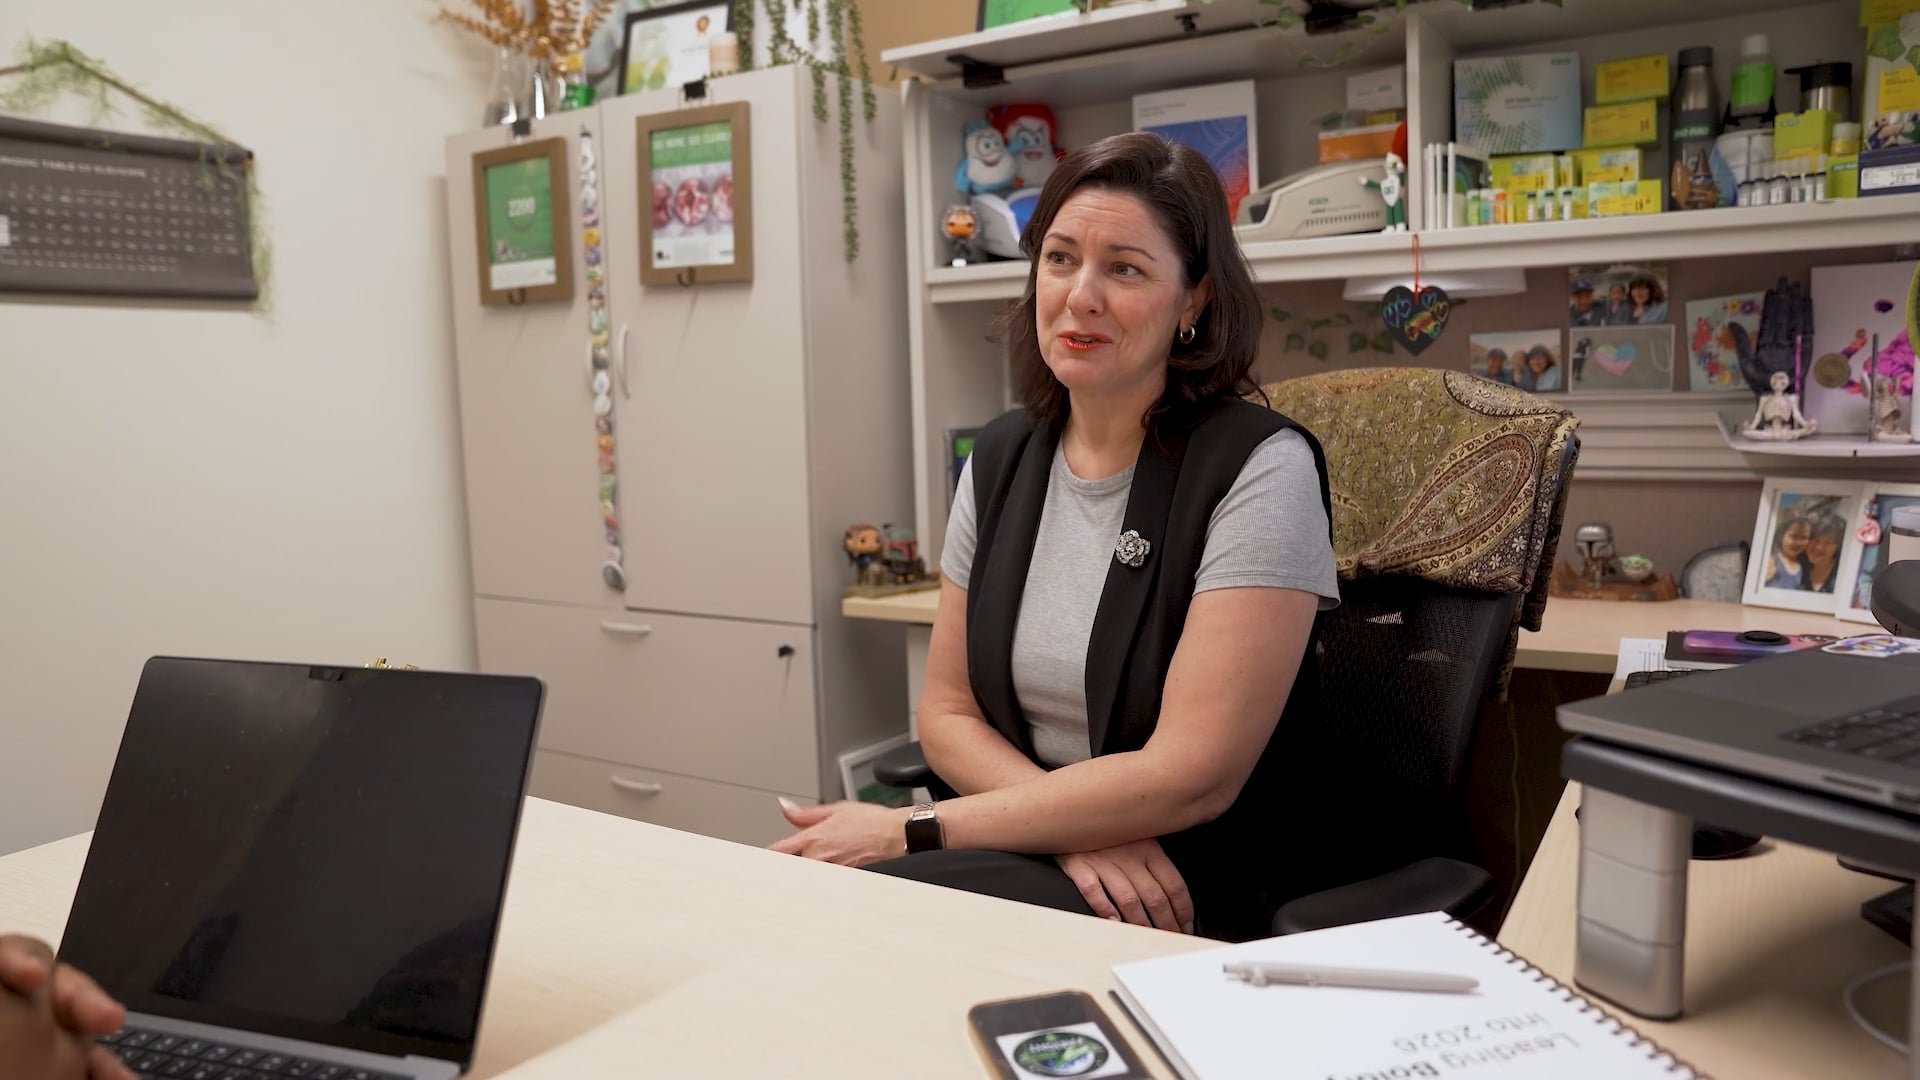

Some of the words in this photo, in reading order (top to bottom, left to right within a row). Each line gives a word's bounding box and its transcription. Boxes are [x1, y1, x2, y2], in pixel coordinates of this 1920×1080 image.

[1485, 1011, 1552, 1031] into
[1393, 1024, 1481, 1053] 2026
[1440, 1031, 1581, 1070] Leading
